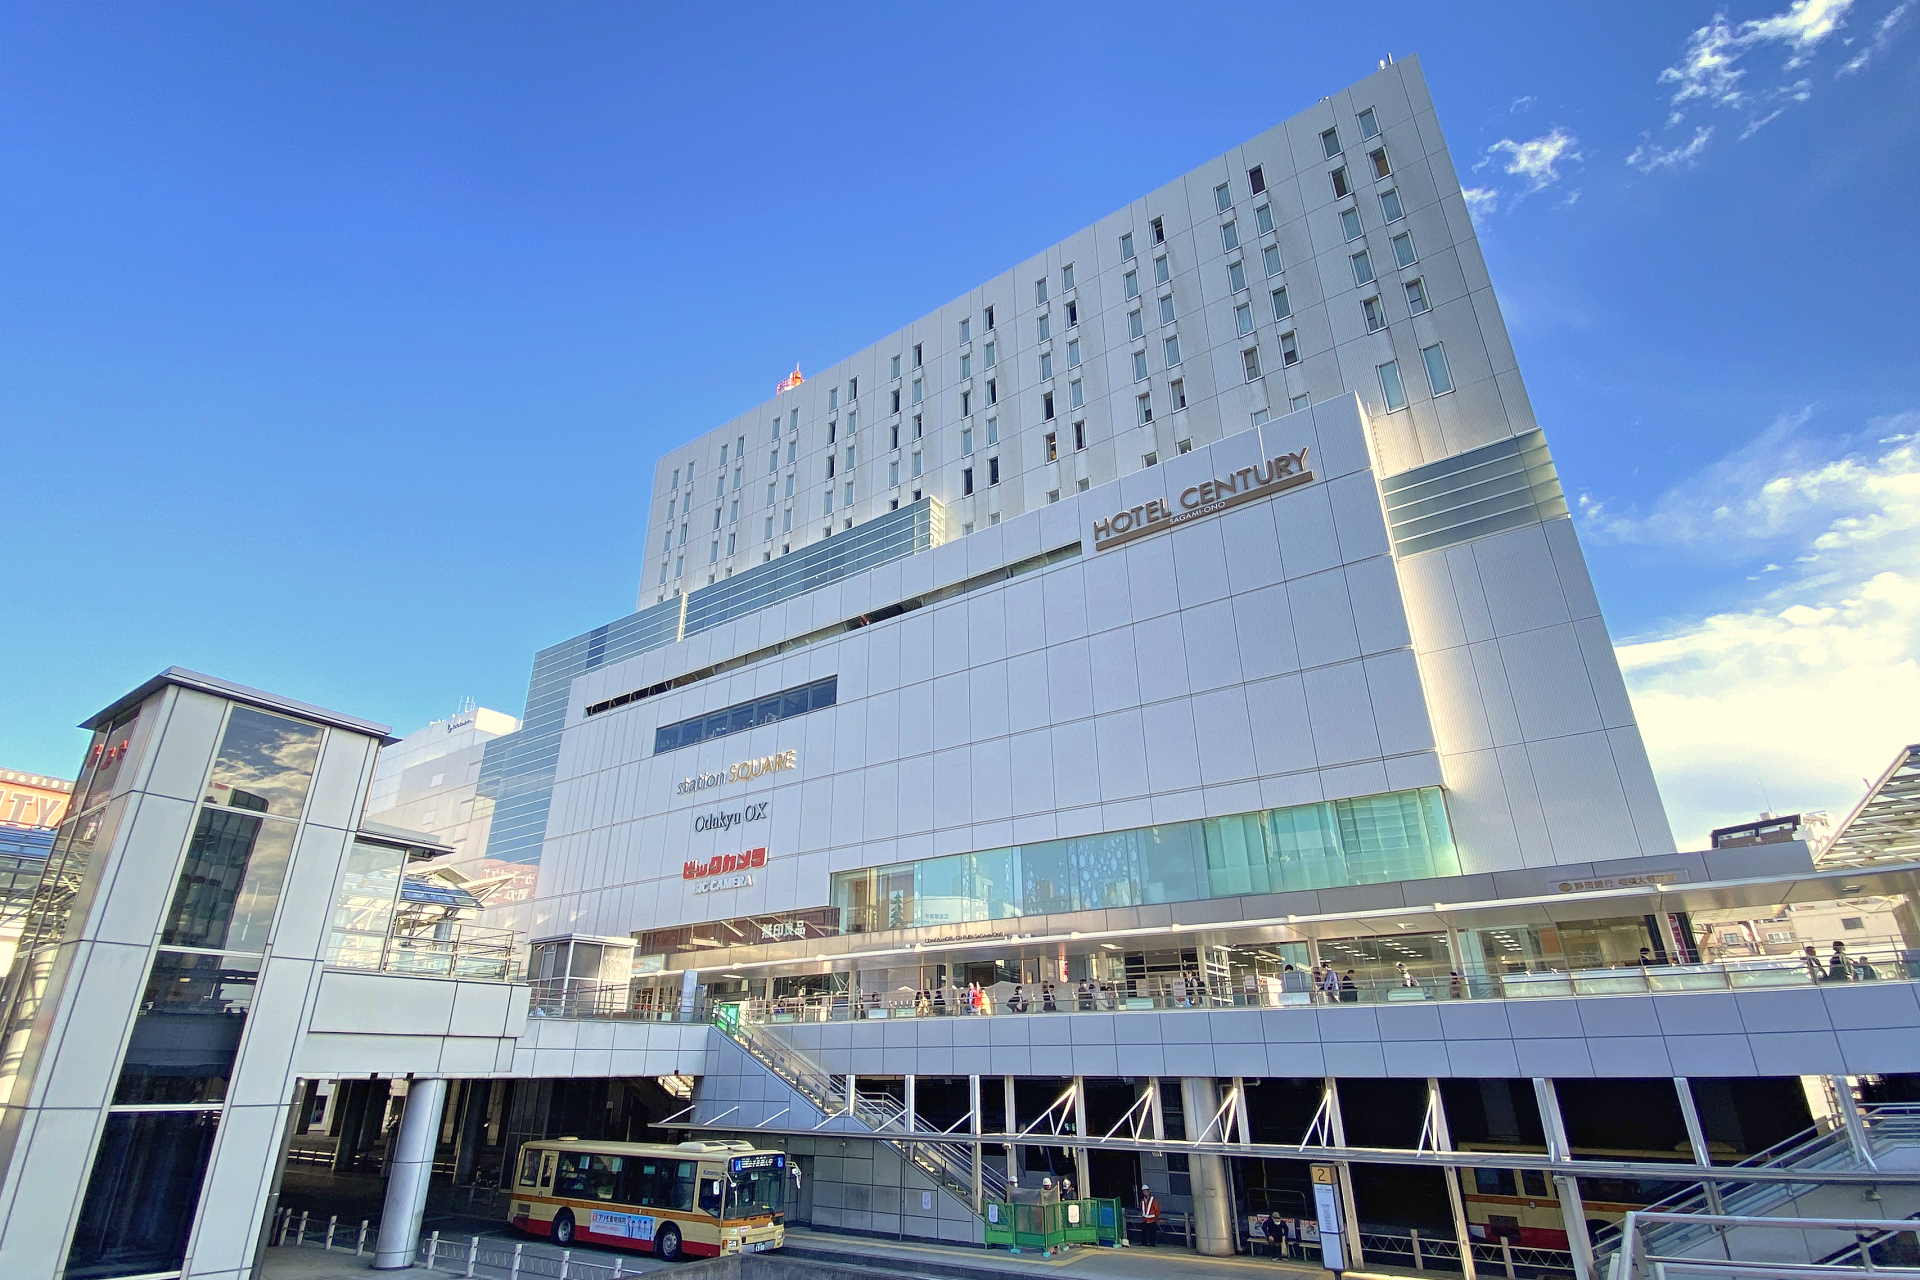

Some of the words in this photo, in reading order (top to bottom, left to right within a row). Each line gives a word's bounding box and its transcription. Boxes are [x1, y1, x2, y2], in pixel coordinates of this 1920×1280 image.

[1093, 496, 1171, 541] HOTEL
[1180, 446, 1309, 508] CENTURY
[677, 771, 726, 795] station
[728, 749, 797, 783] SQUARE
[0, 788, 63, 827] TY
[694, 810, 741, 832] Odakyu
[744, 801, 768, 822] OX
[683, 847, 768, 880] ビックカメラ
[694, 881, 710, 895] BIC
[710, 874, 754, 892] CAMERA
[761, 919, 806, 939] 無印良品
[1317, 1168, 1327, 1182] 2
